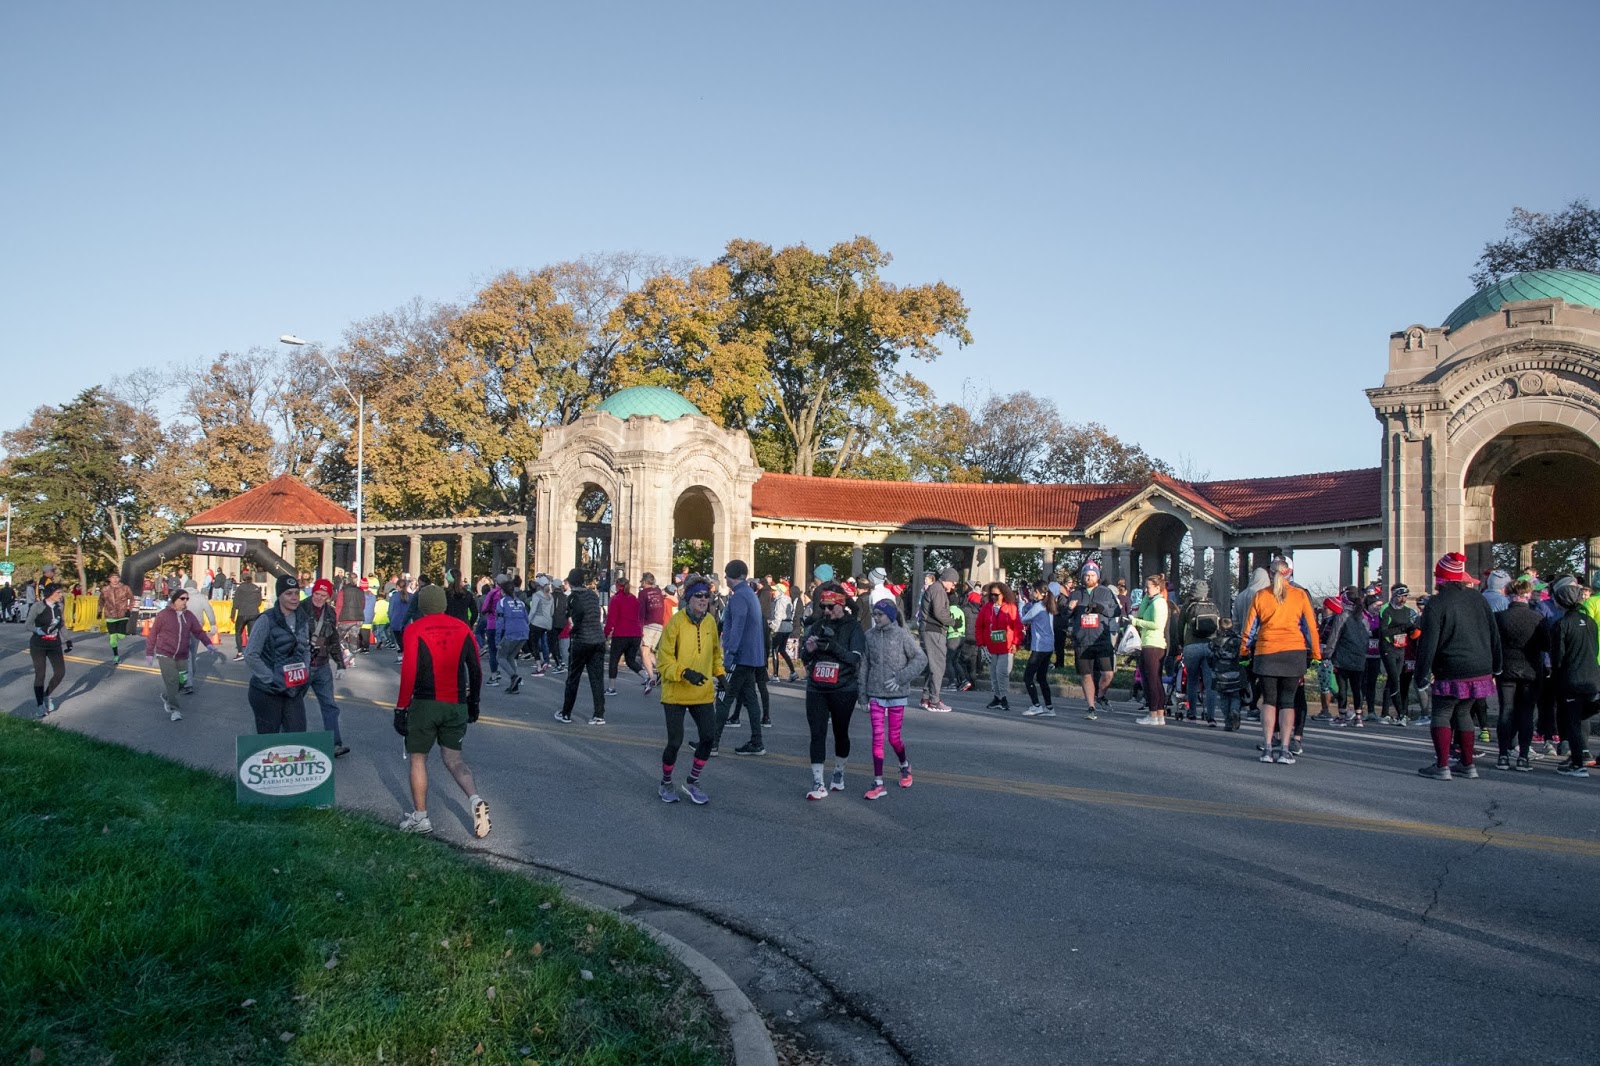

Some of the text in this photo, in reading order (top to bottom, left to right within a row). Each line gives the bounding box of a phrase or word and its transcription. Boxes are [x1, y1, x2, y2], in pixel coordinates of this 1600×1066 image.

[201, 541, 242, 553] START
[288, 668, 305, 682] 2447
[815, 667, 835, 678] 2604
[247, 761, 326, 785] SPROUTS
[263, 775, 322, 785] FARMERS MARKET
